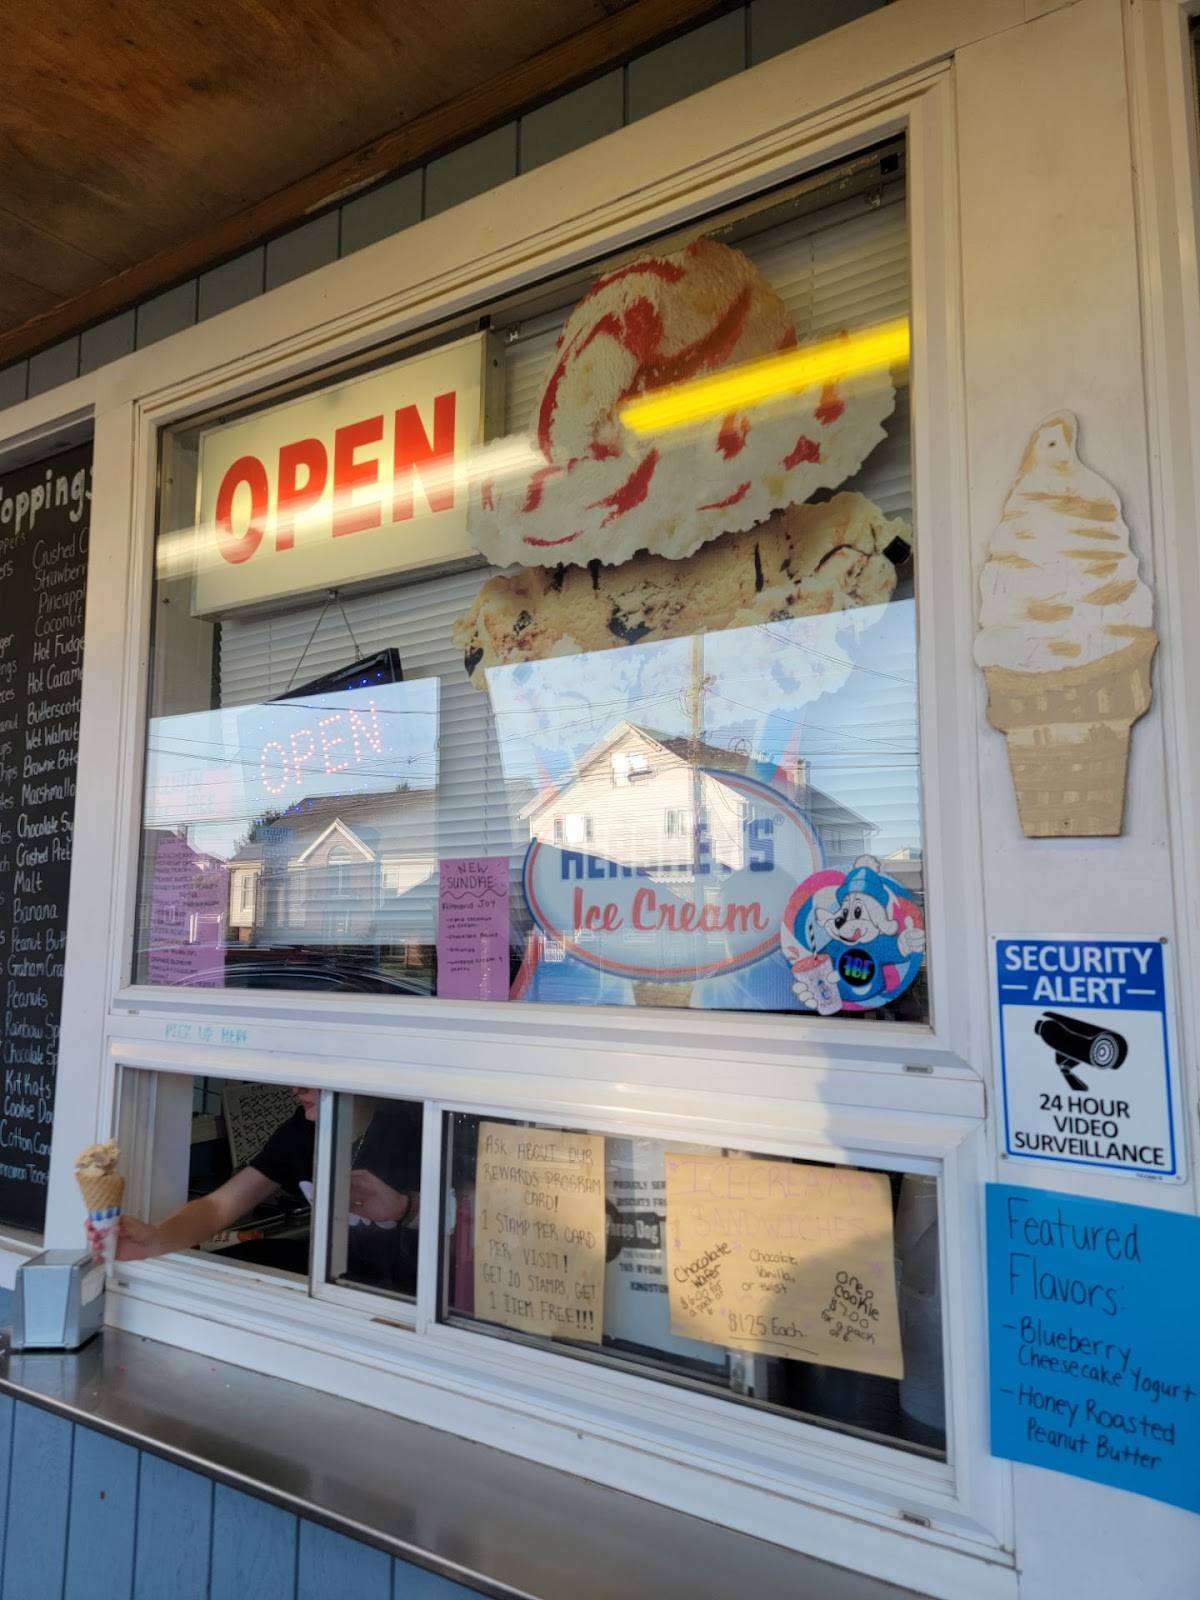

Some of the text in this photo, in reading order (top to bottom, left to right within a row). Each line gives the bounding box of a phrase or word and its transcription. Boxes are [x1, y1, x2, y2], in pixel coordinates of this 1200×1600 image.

[214, 390, 457, 565] OPEN
[0, 468, 93, 537] opping
[34, 606, 83, 638] Coconut
[33, 638, 50, 664] Hot
[27, 667, 44, 697] Hot
[260, 699, 382, 794] OPEN
[13, 870, 43, 895] Malt
[446, 875, 496, 889] SUNDAE
[457, 863, 489, 874] NEW
[12, 897, 59, 924] Banana
[573, 886, 770, 933] Ice Cream
[11, 926, 42, 953] Peanut
[1005, 945, 1153, 975] SECURITY
[6, 979, 49, 1009] Peanuts
[1033, 975, 1127, 1005] ALERT
[4, 1010, 43, 1040] Rainbow
[3, 1095, 35, 1120] Cookie
[1040, 1093, 1131, 1119] 24 HOUR
[1053, 1115, 1119, 1139] VIDEO
[485, 1134, 593, 1166] ASK ABOUT OUR
[1014, 1131, 1166, 1167] SURVEILLANCE
[483, 1163, 601, 1194] REWARDS PROGRAM
[524, 1190, 559, 1212] CARD!
[481, 1209, 596, 1249] 1 STAMP PER CARD
[635, 1220, 660, 1245] Dog
[1007, 1196, 1142, 1263] Featured
[489, 1239, 511, 1260] PER
[674, 1242, 732, 1283] Chocolate
[482, 1263, 501, 1284] GET
[508, 1269, 520, 1288] 10
[575, 1282, 596, 1301] GET
[490, 1291, 594, 1331] 1 ITEM FREE!!!
[1020, 1315, 1132, 1372] Blueberry
[1017, 1345, 1198, 1404] Cheesecake Yogurt
[1018, 1385, 1176, 1446] Honey Roasted
[1027, 1416, 1163, 1471] Peanut Butter
